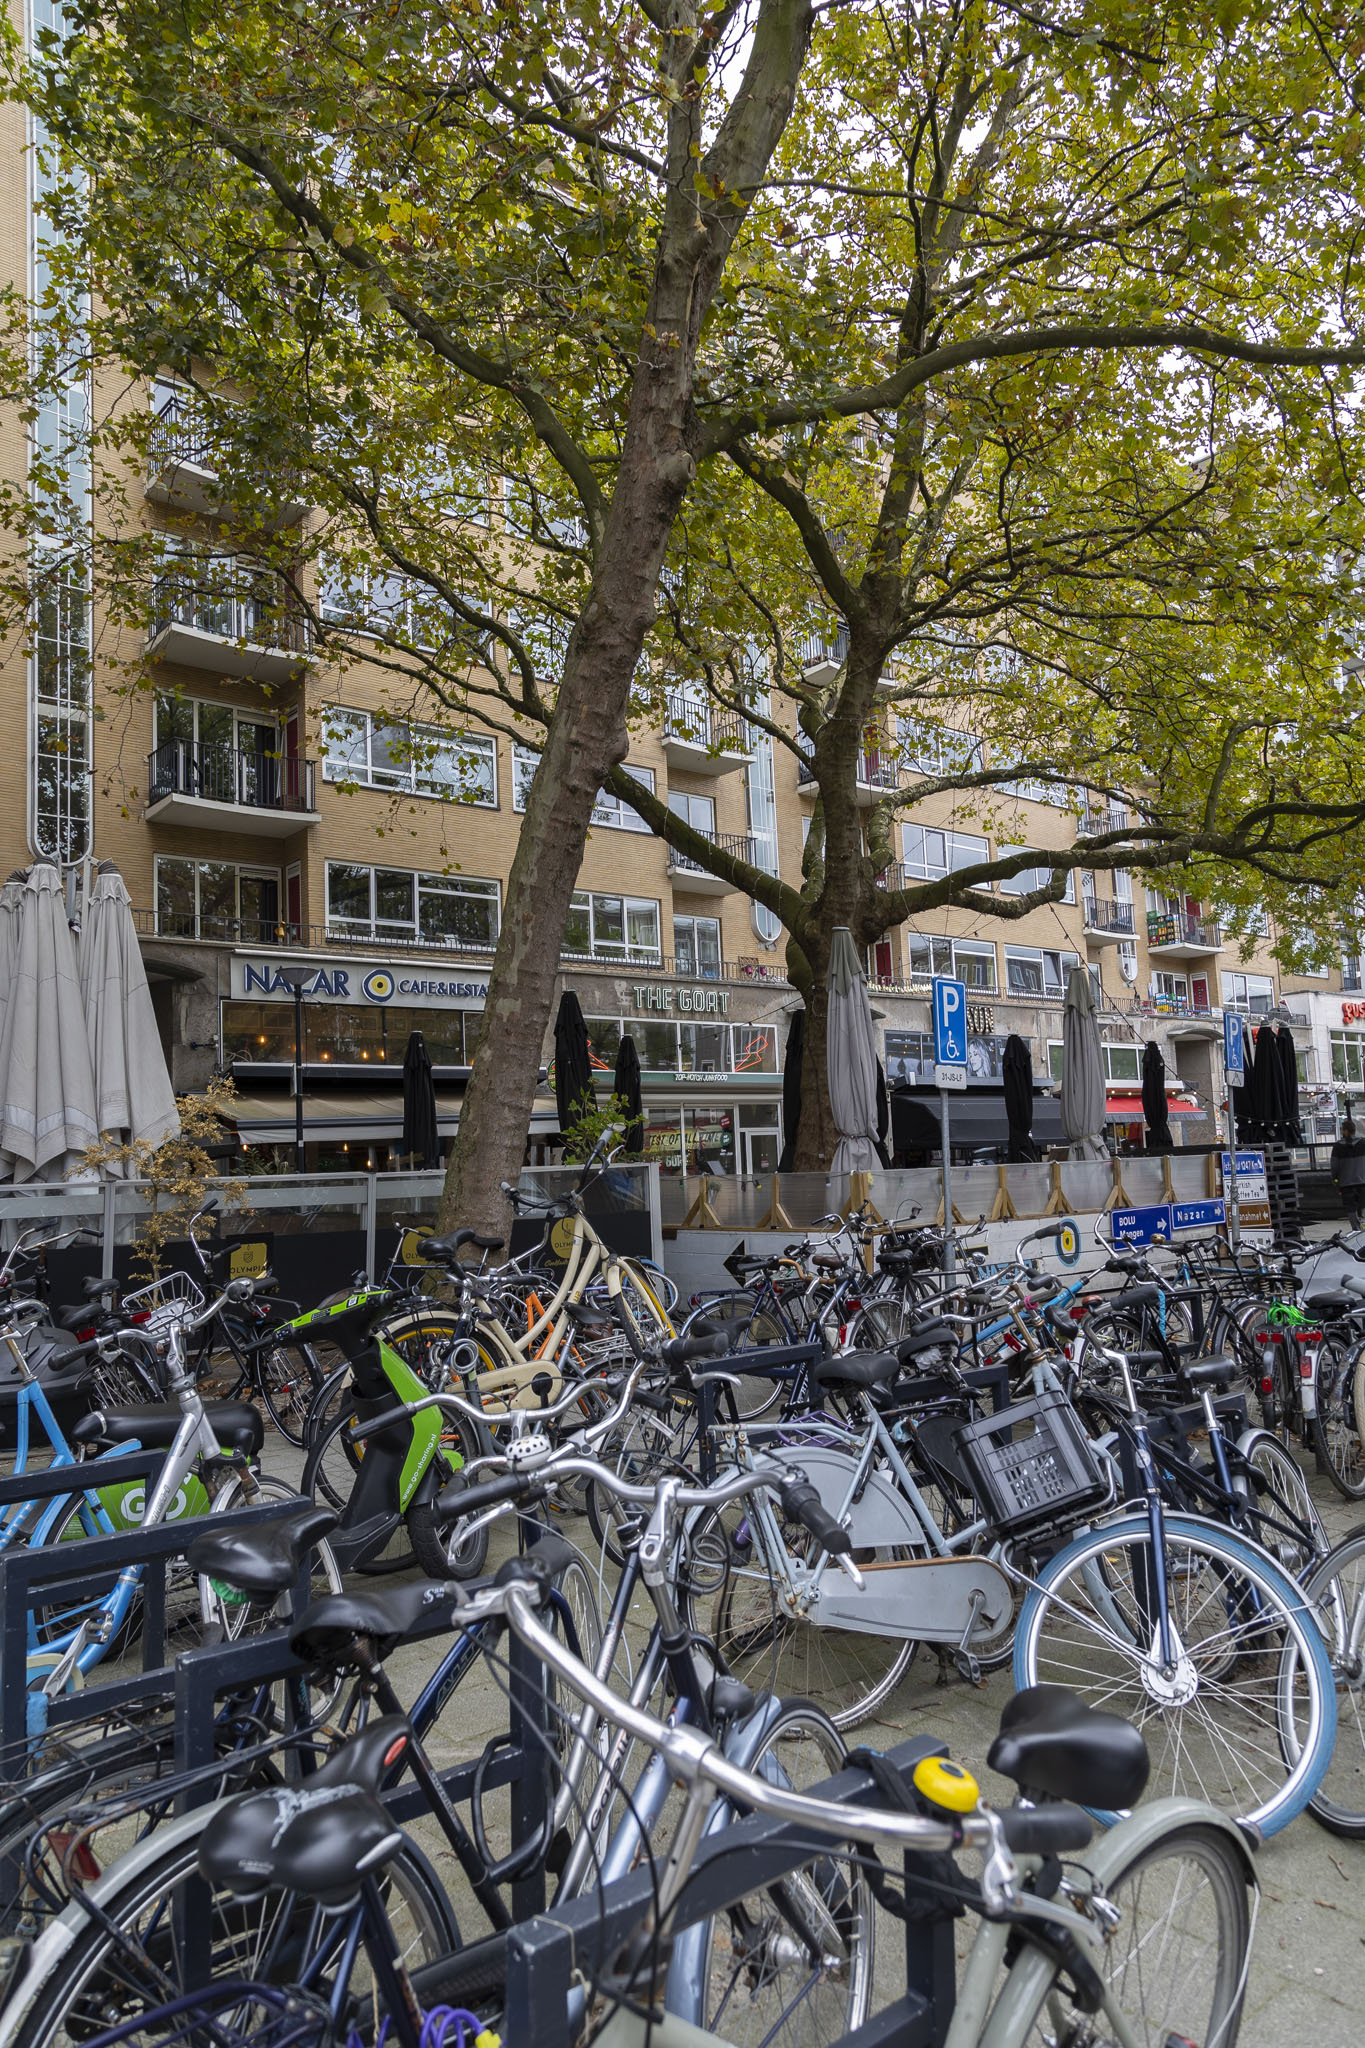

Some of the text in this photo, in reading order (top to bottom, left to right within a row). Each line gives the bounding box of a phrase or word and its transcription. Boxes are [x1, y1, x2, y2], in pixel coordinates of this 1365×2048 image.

[244, 963, 489, 998] NAAR CAFE&RESTA
[633, 986, 730, 1013] THE GOAT
[943, 986, 959, 1027] P
[1230, 1018, 1238, 1046] P
[941, 1072, 963, 1082] 31-JS-LF
[668, 1133, 681, 1145] OF
[1251, 1189, 1260, 1198] Tea
[1119, 1216, 1136, 1226] BOLU
[1177, 1210, 1204, 1221] Nazar
[230, 1265, 266, 1274] OLYMPIA
[402, 1433, 437, 1500] www.go-sharing.nl
